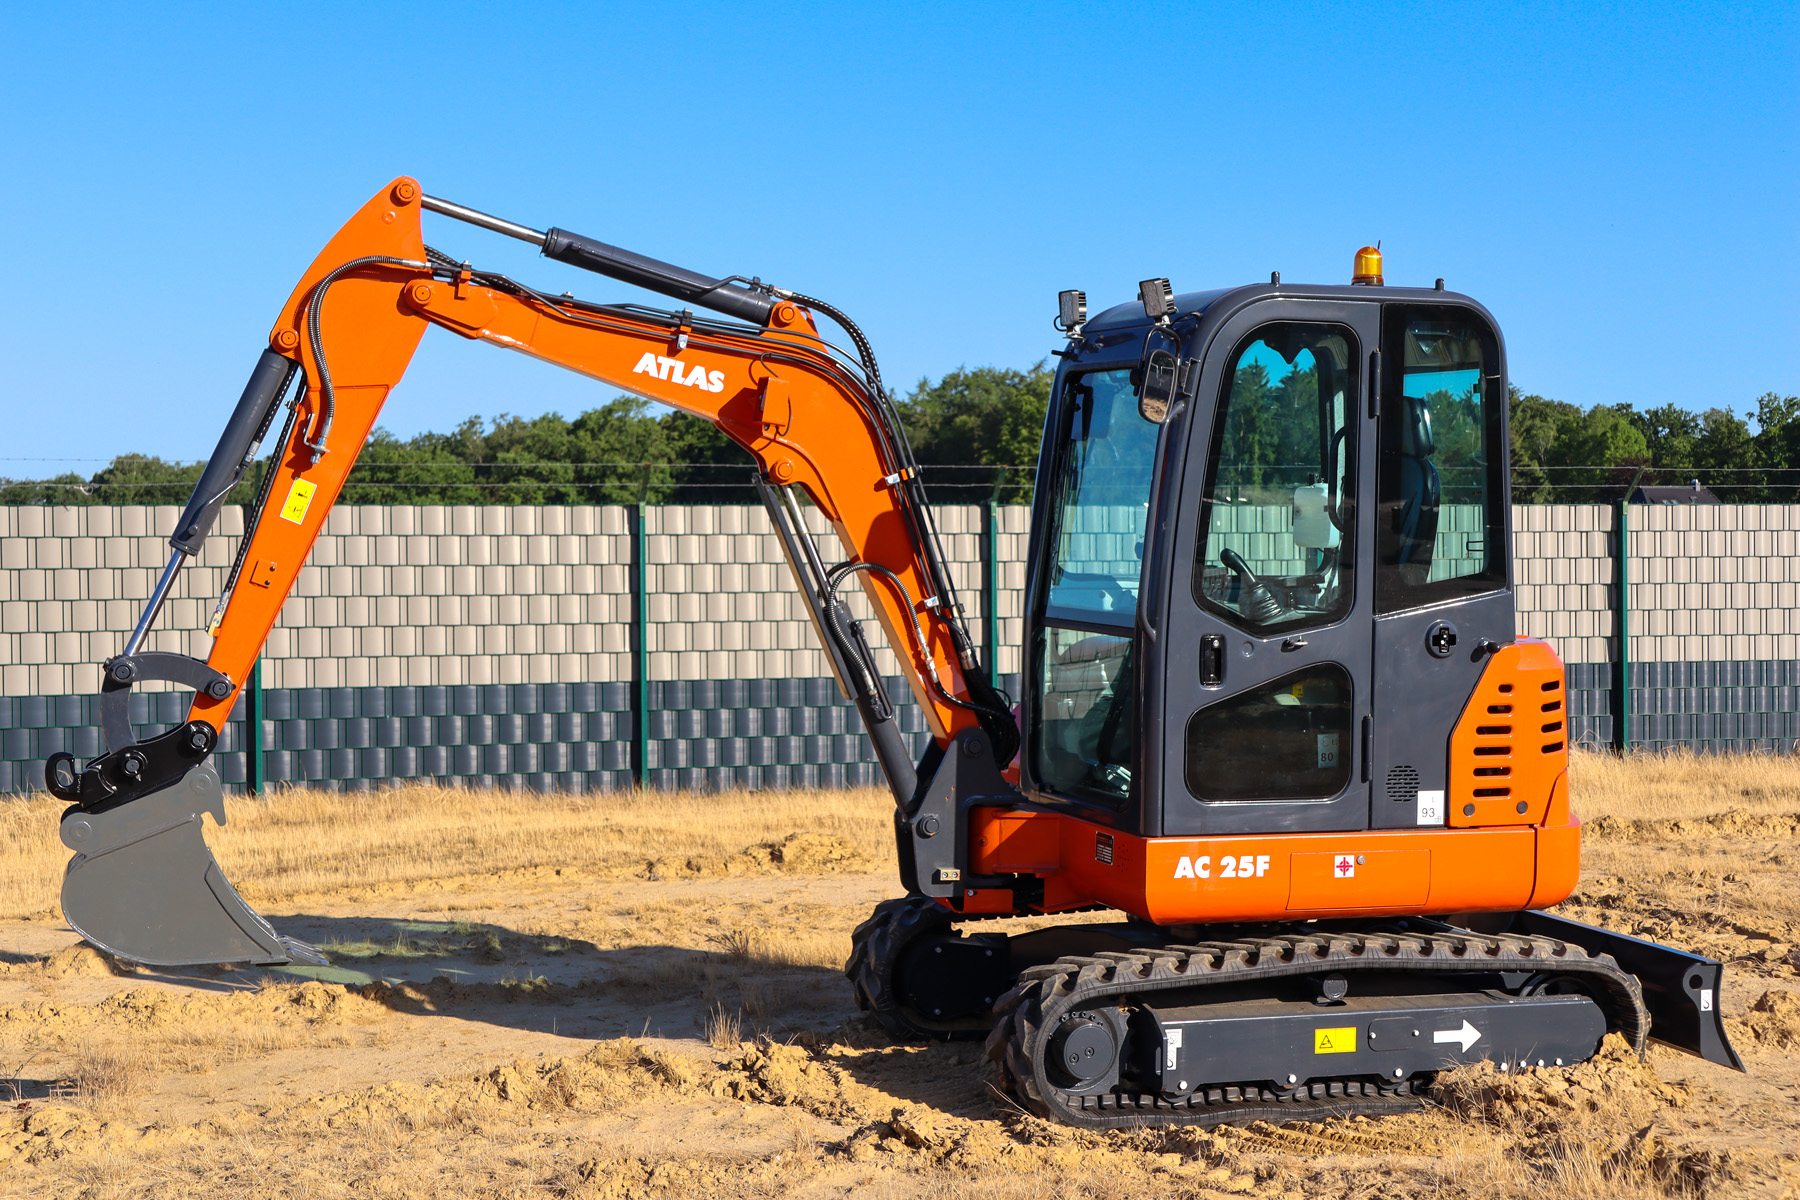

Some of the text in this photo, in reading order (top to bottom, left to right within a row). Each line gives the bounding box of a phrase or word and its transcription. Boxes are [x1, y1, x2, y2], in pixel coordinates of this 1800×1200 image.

[632, 352, 725, 393] ATLAS
[1321, 752, 1334, 762] 80
[1421, 807, 1436, 818] 93
[1173, 855, 1271, 879] AC 25F
